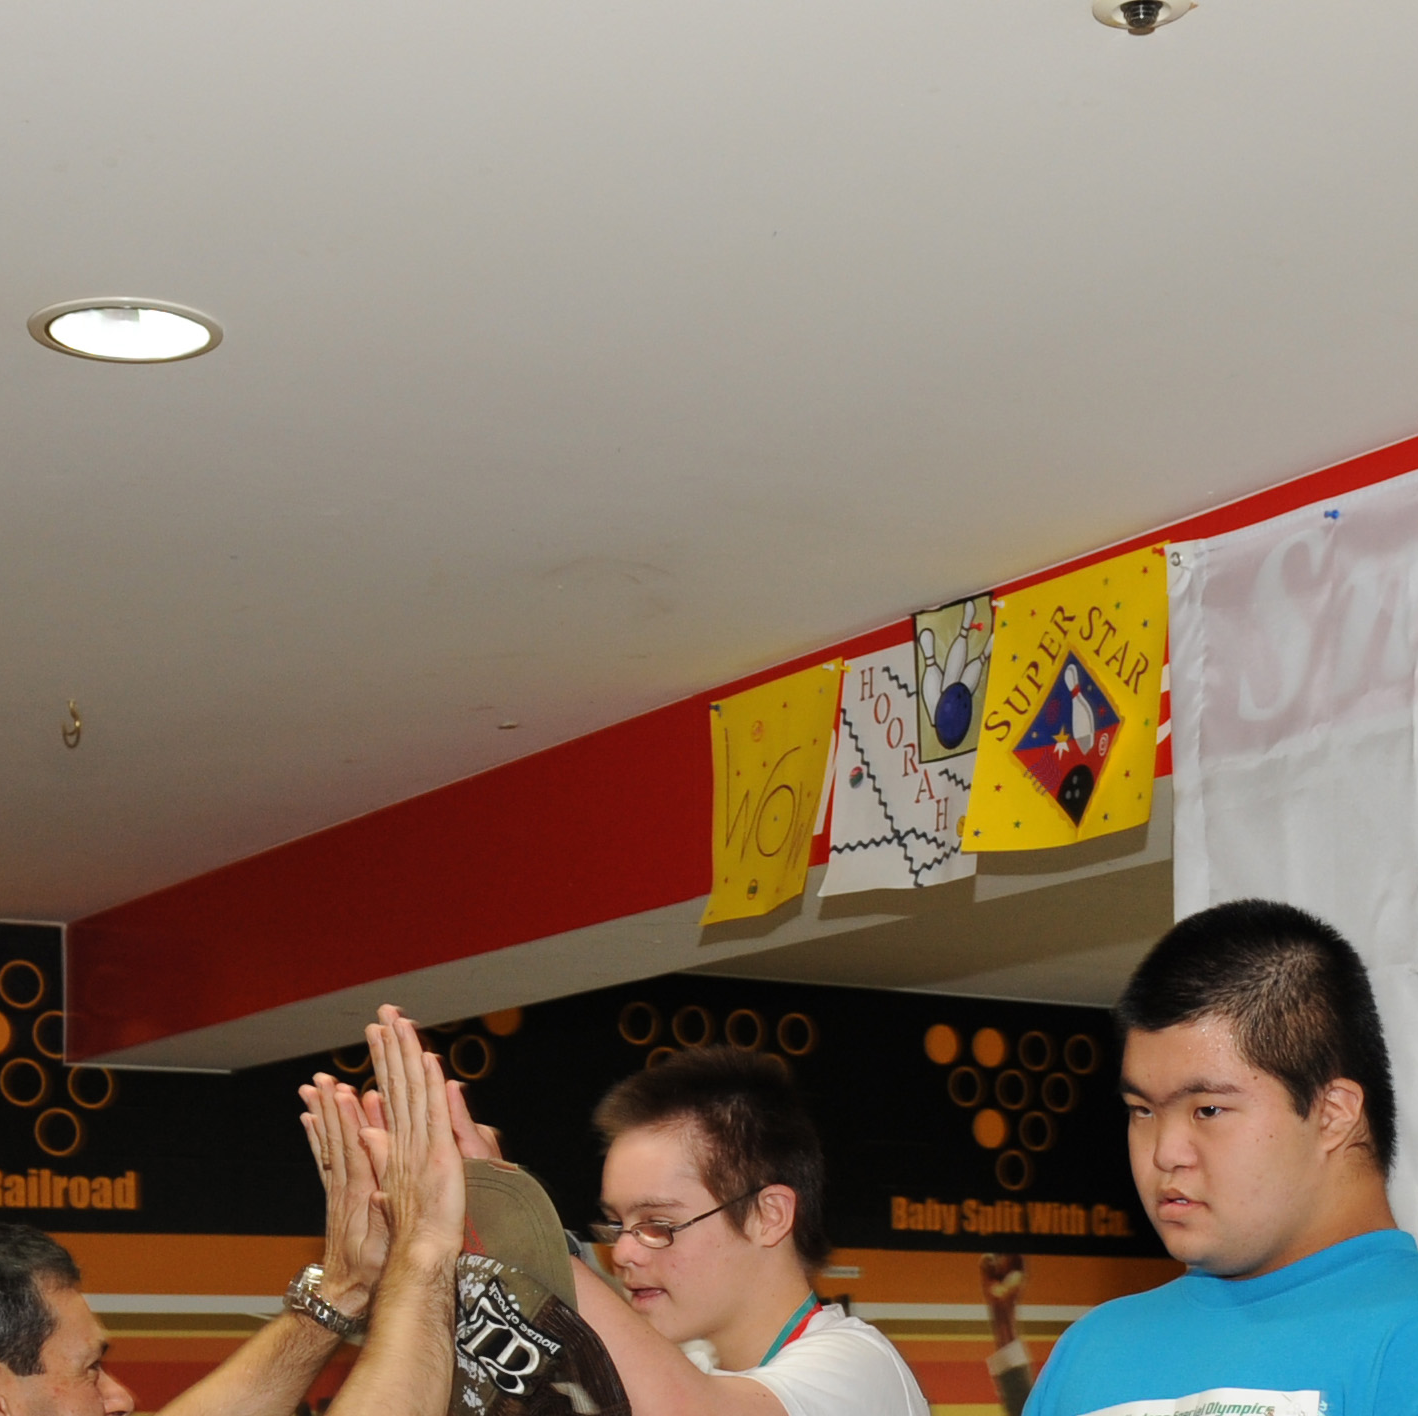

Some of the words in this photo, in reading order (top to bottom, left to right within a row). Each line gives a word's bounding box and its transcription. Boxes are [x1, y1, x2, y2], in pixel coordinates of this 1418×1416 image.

[984, 604, 1076, 743] SUPER
[1079, 605, 1149, 695] STAR
[858, 666, 949, 832] HOORAH
[890, 1195, 959, 1235] Baby
[961, 1198, 1026, 1236] Split
[1026, 1201, 1089, 1236] With
